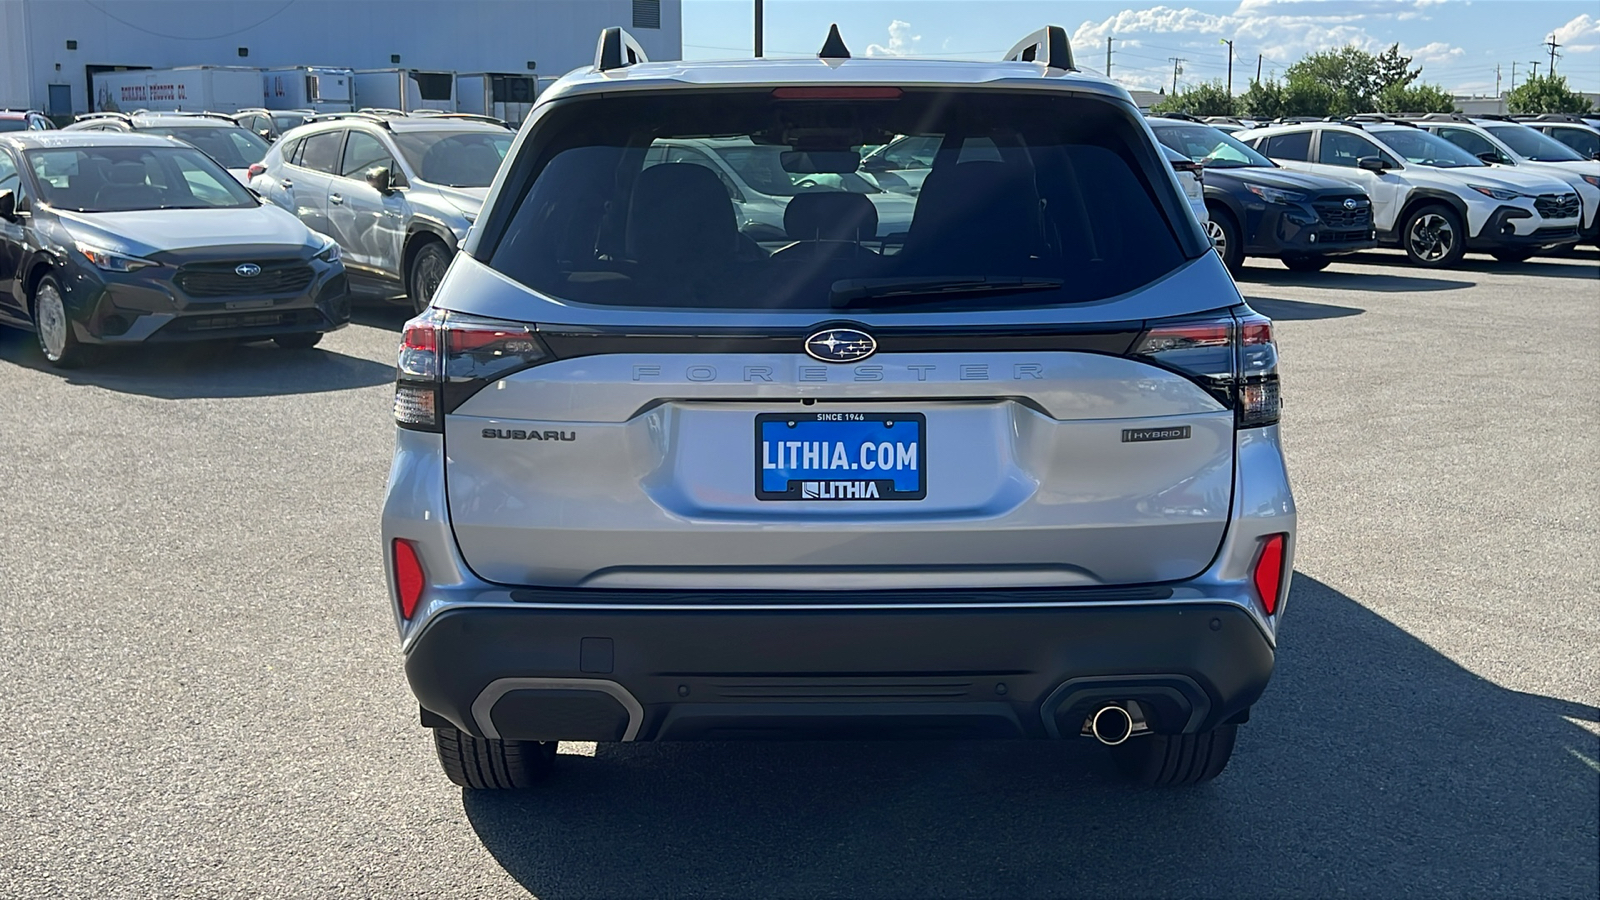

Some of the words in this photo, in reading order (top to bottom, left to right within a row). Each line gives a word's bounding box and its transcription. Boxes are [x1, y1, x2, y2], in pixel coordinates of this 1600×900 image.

[633, 363, 1043, 382] FORESTER
[817, 413, 843, 421] SINCE
[845, 413, 865, 421] 1946
[481, 428, 576, 441] SUBARU
[1134, 430, 1181, 439] HYBRID
[763, 441, 917, 470] LITHIA.COM
[820, 481, 880, 499] LITHIA
